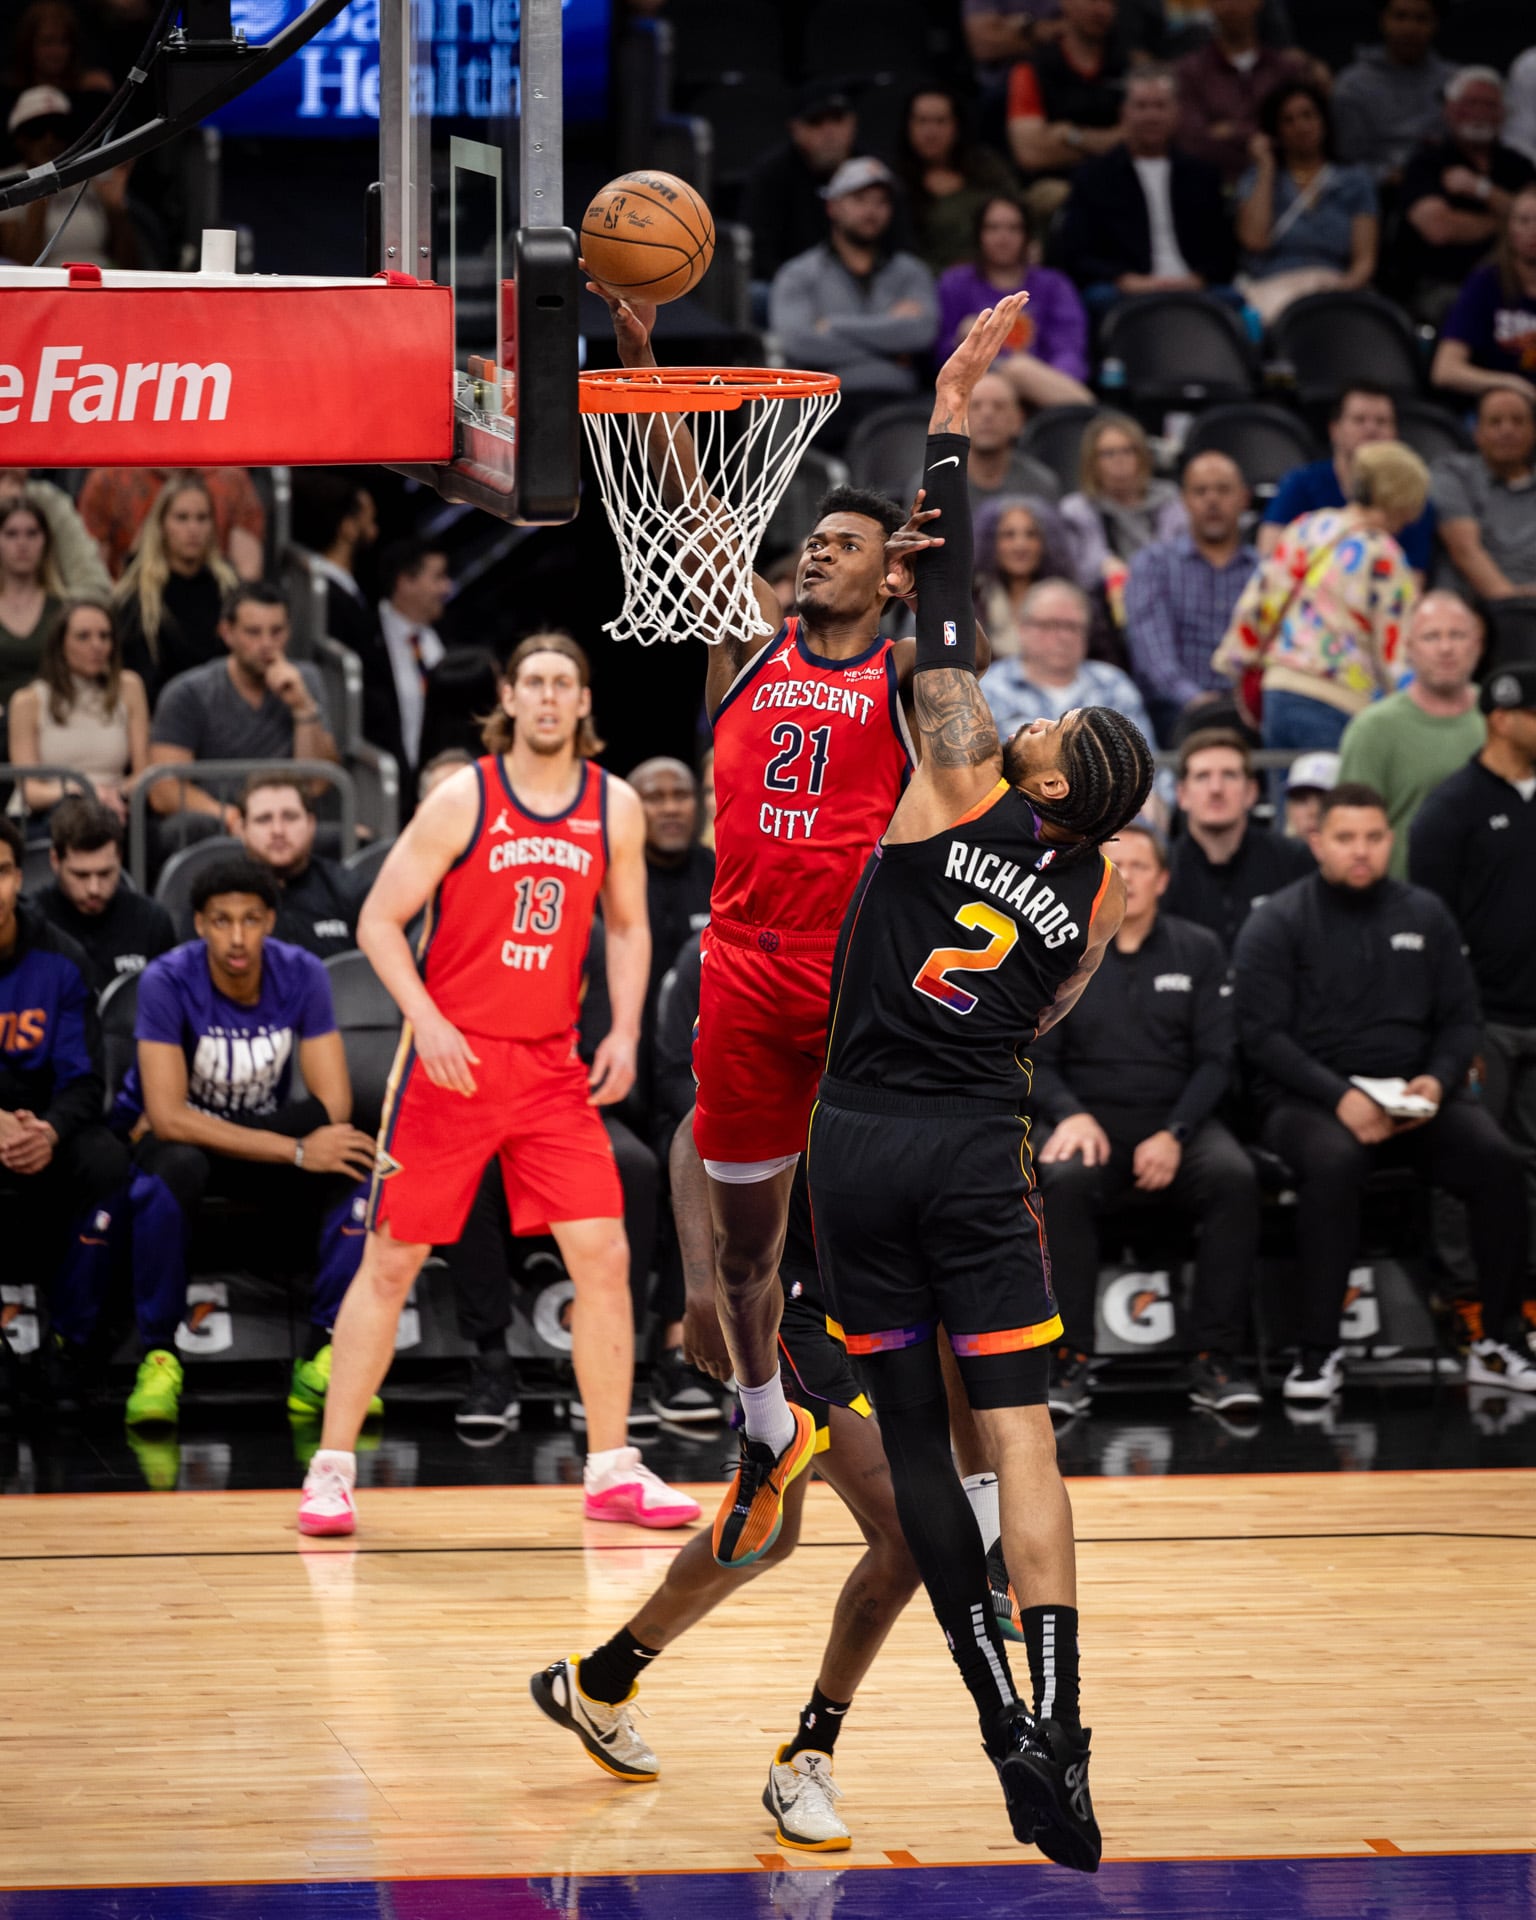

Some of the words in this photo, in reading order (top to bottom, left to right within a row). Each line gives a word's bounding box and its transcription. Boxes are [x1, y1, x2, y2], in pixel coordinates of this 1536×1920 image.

[752, 680, 874, 725] CRESCENT
[764, 721, 832, 796] 21
[759, 802, 819, 839] CITY
[489, 836, 593, 877] CRESCENT
[512, 875, 565, 935] 13
[945, 840, 1079, 949] RICHARDS
[501, 939, 553, 972] CITY
[912, 901, 1019, 1015] 2
